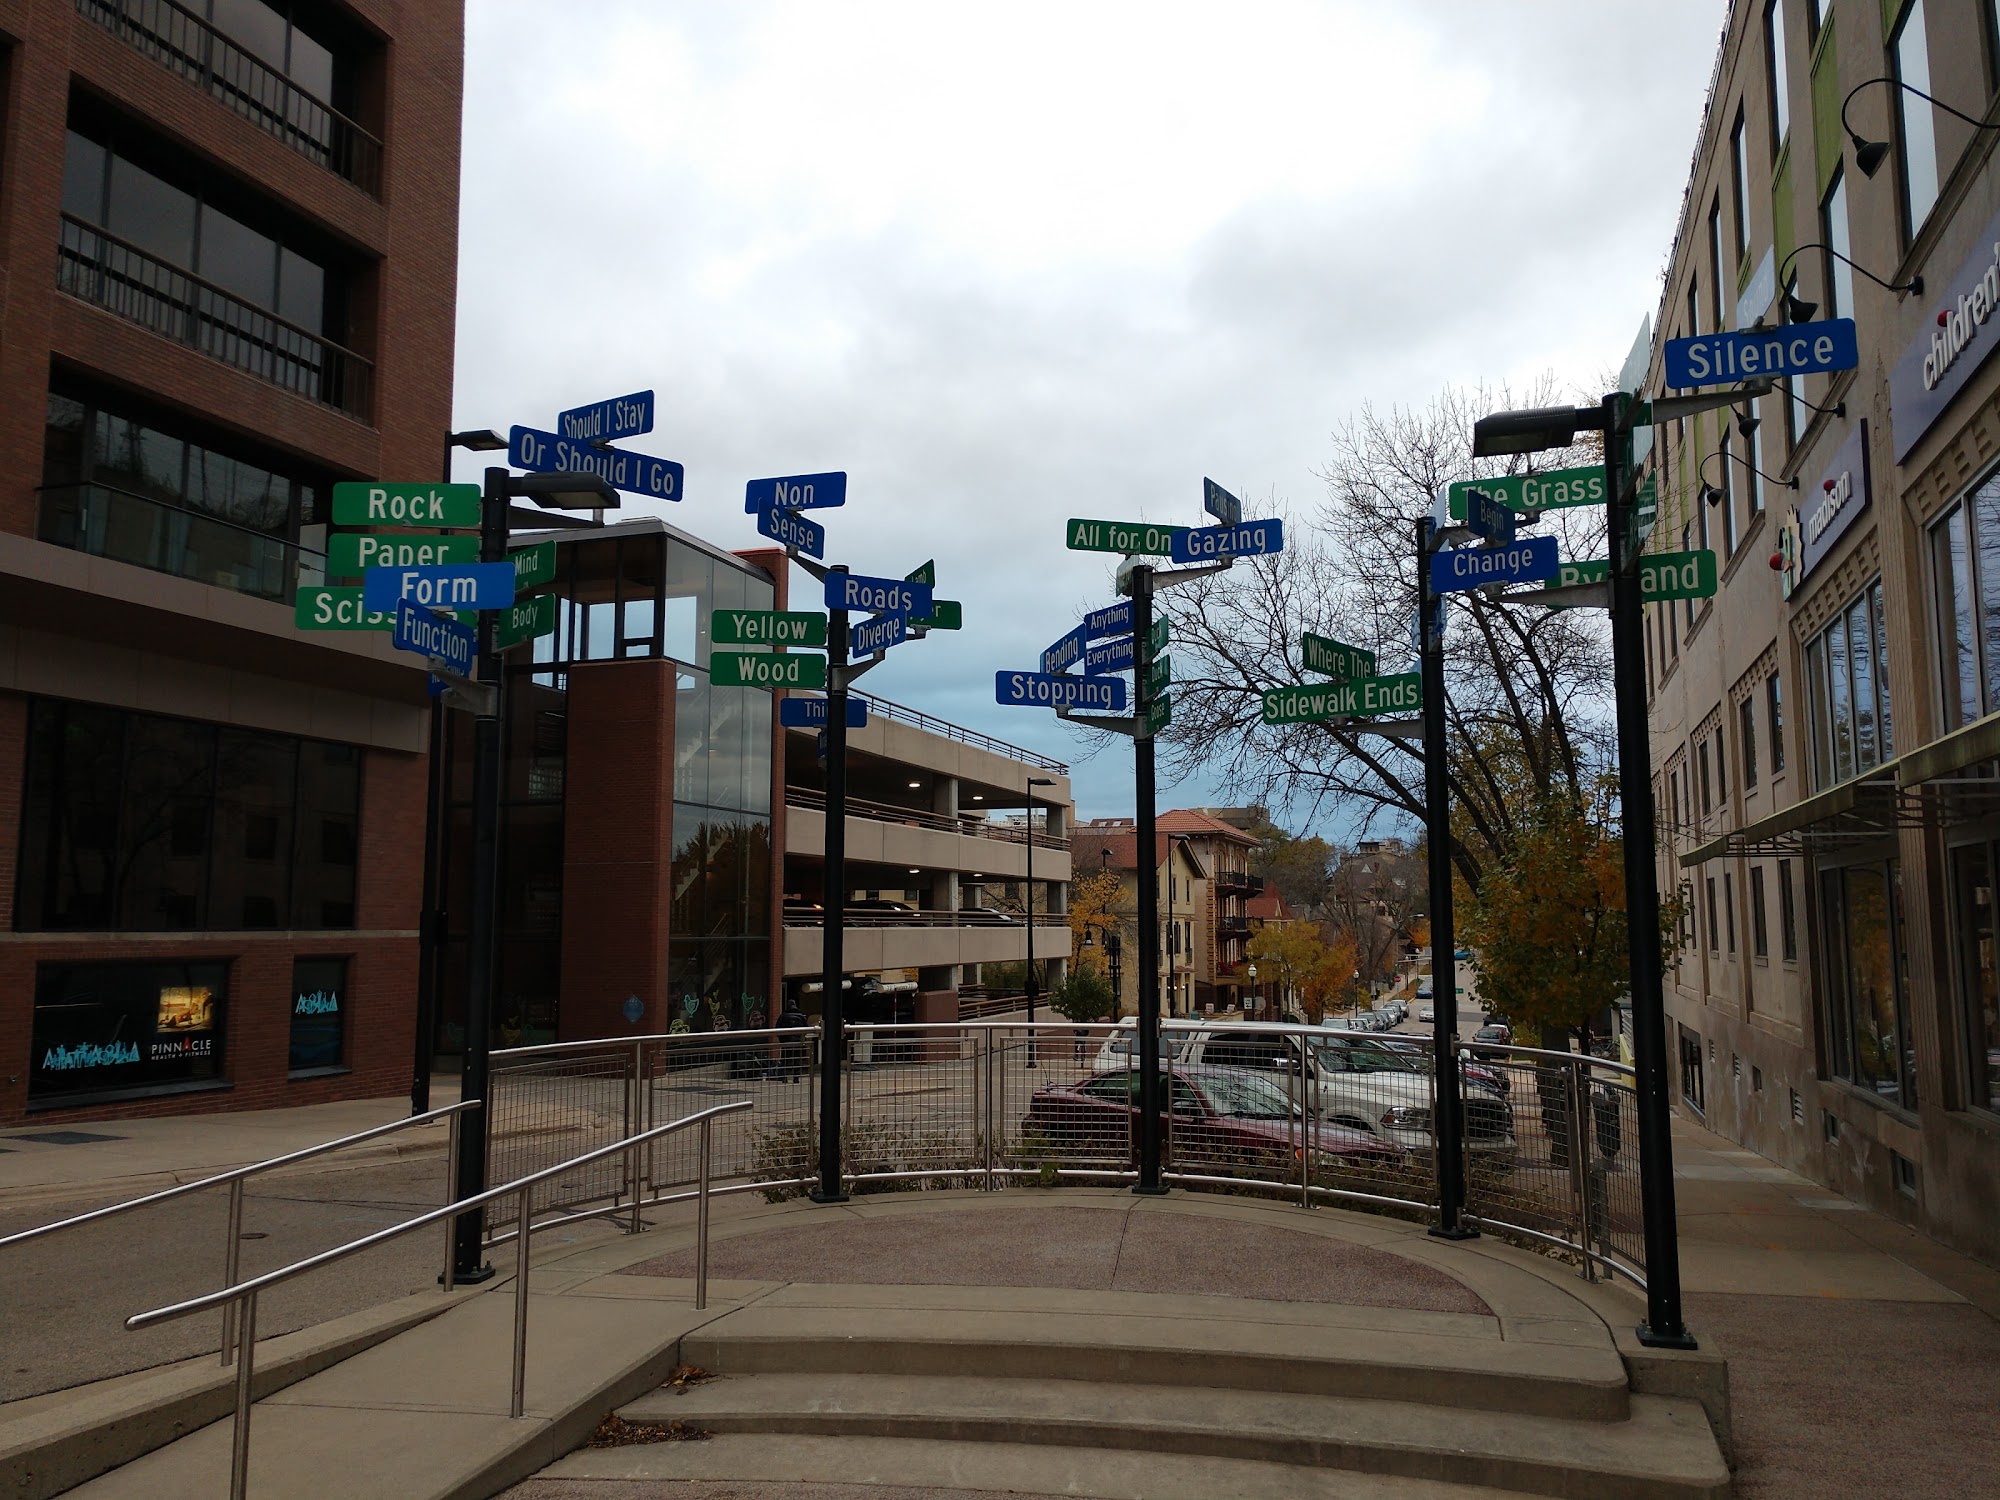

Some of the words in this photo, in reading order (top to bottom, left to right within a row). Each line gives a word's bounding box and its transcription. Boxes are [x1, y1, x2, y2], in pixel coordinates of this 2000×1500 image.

[1688, 335, 1834, 379] Silence
[564, 407, 600, 440] Should
[605, 404, 611, 433] I
[615, 400, 646, 434] Stay
[521, 433, 546, 466] Or
[555, 441, 627, 485] Should
[635, 460, 641, 487] I
[650, 463, 674, 495] Go
[368, 489, 445, 519] Rock
[775, 482, 814, 505] Non
[1522, 478, 1603, 507] Grass
[1480, 500, 1504, 534] Begin
[1809, 471, 1850, 545] madison
[770, 509, 814, 549] Sense
[1074, 523, 1099, 546] All
[1108, 525, 1139, 549] for
[1187, 526, 1266, 556] Gazing
[358, 537, 450, 567] Paper
[515, 550, 538, 577] Mind
[1454, 548, 1533, 576] Change
[402, 572, 477, 604] Form
[845, 579, 913, 611] Roads
[512, 604, 538, 629] Body
[732, 614, 808, 640] Yellow
[1091, 606, 1129, 630] Anything
[403, 607, 468, 662] Function
[858, 618, 900, 651] Diverge
[738, 656, 799, 682] Wood
[1045, 637, 1078, 674] Bending
[1086, 642, 1134, 667] Everything
[1308, 638, 1345, 674] Where
[1350, 651, 1371, 679] The
[1152, 665, 1162, 682] Duck
[1011, 674, 1112, 710] Stopping
[1266, 687, 1357, 719] Sidewalk
[1364, 680, 1418, 709] Ends
[1151, 701, 1165, 721] Goose
[151, 1037, 211, 1054] PINNACLE
